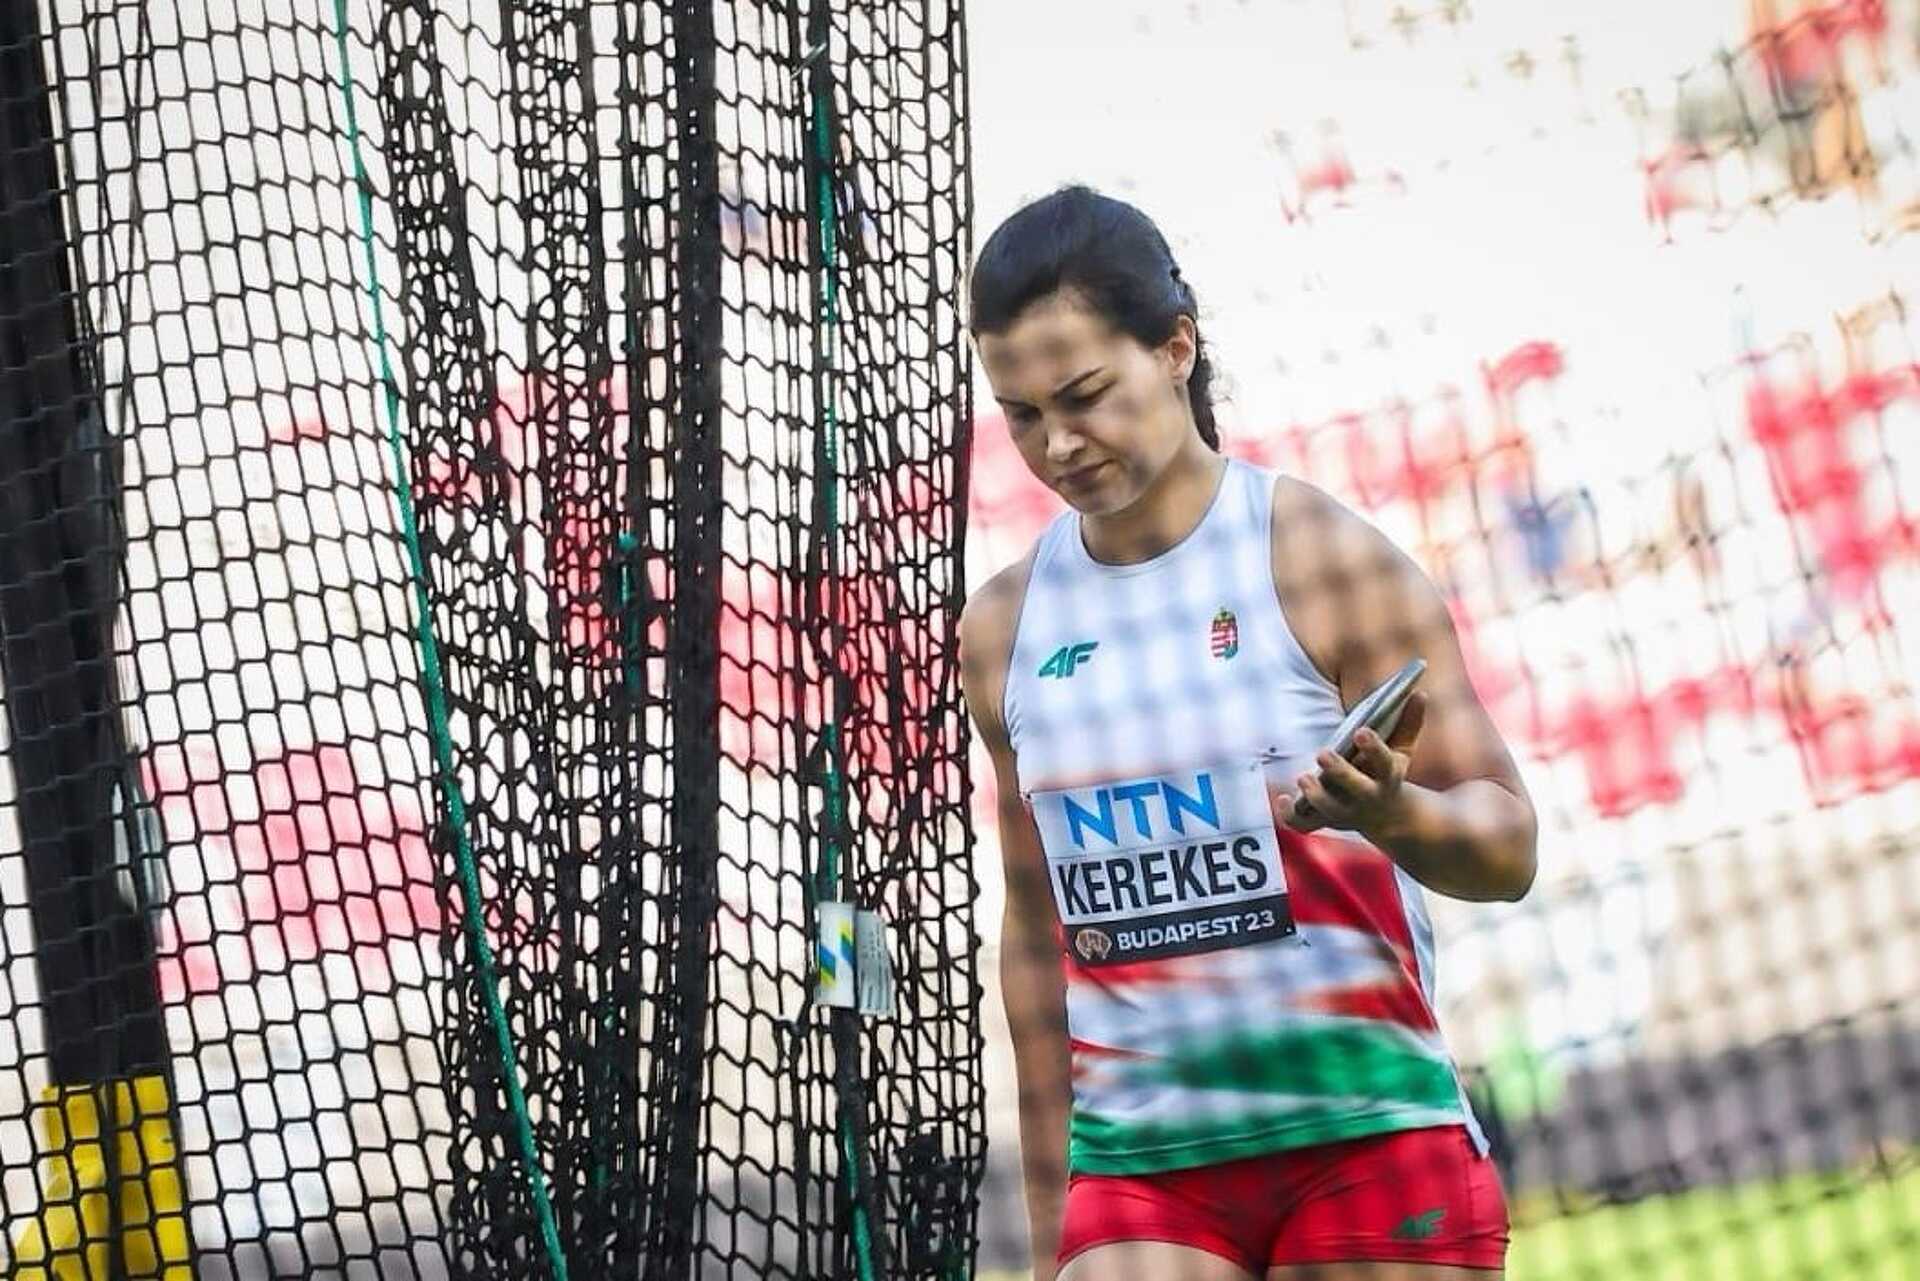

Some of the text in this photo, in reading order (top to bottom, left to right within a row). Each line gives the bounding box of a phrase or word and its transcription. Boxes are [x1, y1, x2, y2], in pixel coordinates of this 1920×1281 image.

[1038, 641, 1099, 679] 4F
[1063, 772, 1220, 850] NTN
[1057, 836, 1267, 917] KEREKES
[1117, 909, 1275, 950] BUDAPEST 23
